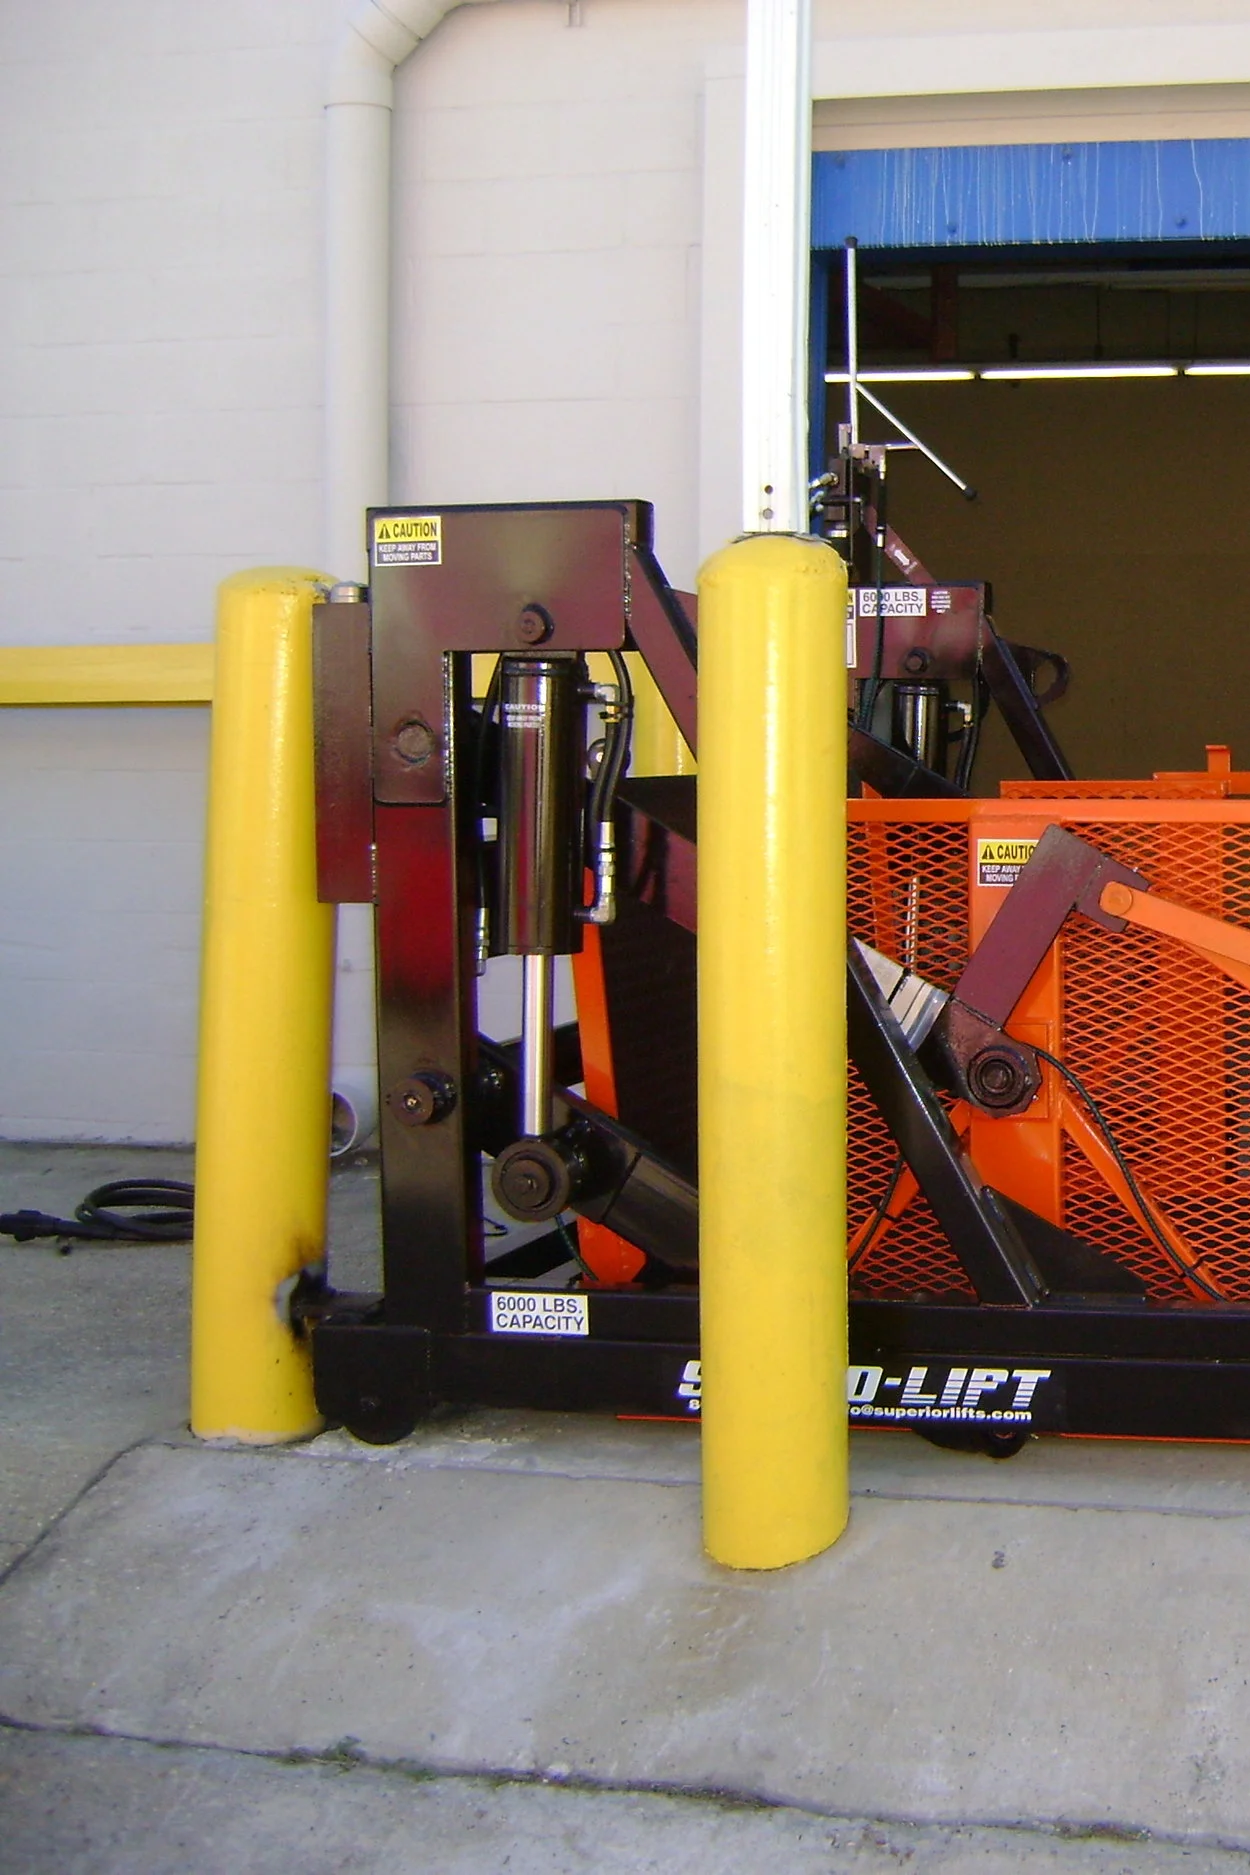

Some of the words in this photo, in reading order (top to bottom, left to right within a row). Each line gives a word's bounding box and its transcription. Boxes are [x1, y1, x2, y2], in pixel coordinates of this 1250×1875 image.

[393, 522, 437, 538] CAUTION
[378, 544, 397, 553] KEEP
[397, 543, 416, 552] AWAY
[417, 543, 437, 552] FROM
[383, 553, 409, 562] MOVING
[410, 552, 433, 561] PARTS
[894, 591, 922, 602] LBS.
[997, 845, 1036, 859] CAUTIO
[981, 865, 1001, 873] KEEP
[1001, 865, 1020, 873] AWAY
[985, 874, 1014, 882] MOVING
[497, 1296, 536, 1312] 6000
[543, 1298, 582, 1314] LBS.
[496, 1313, 584, 1331] CAPACITY
[848, 1403, 1032, 1421] o@superiorlifts.com
